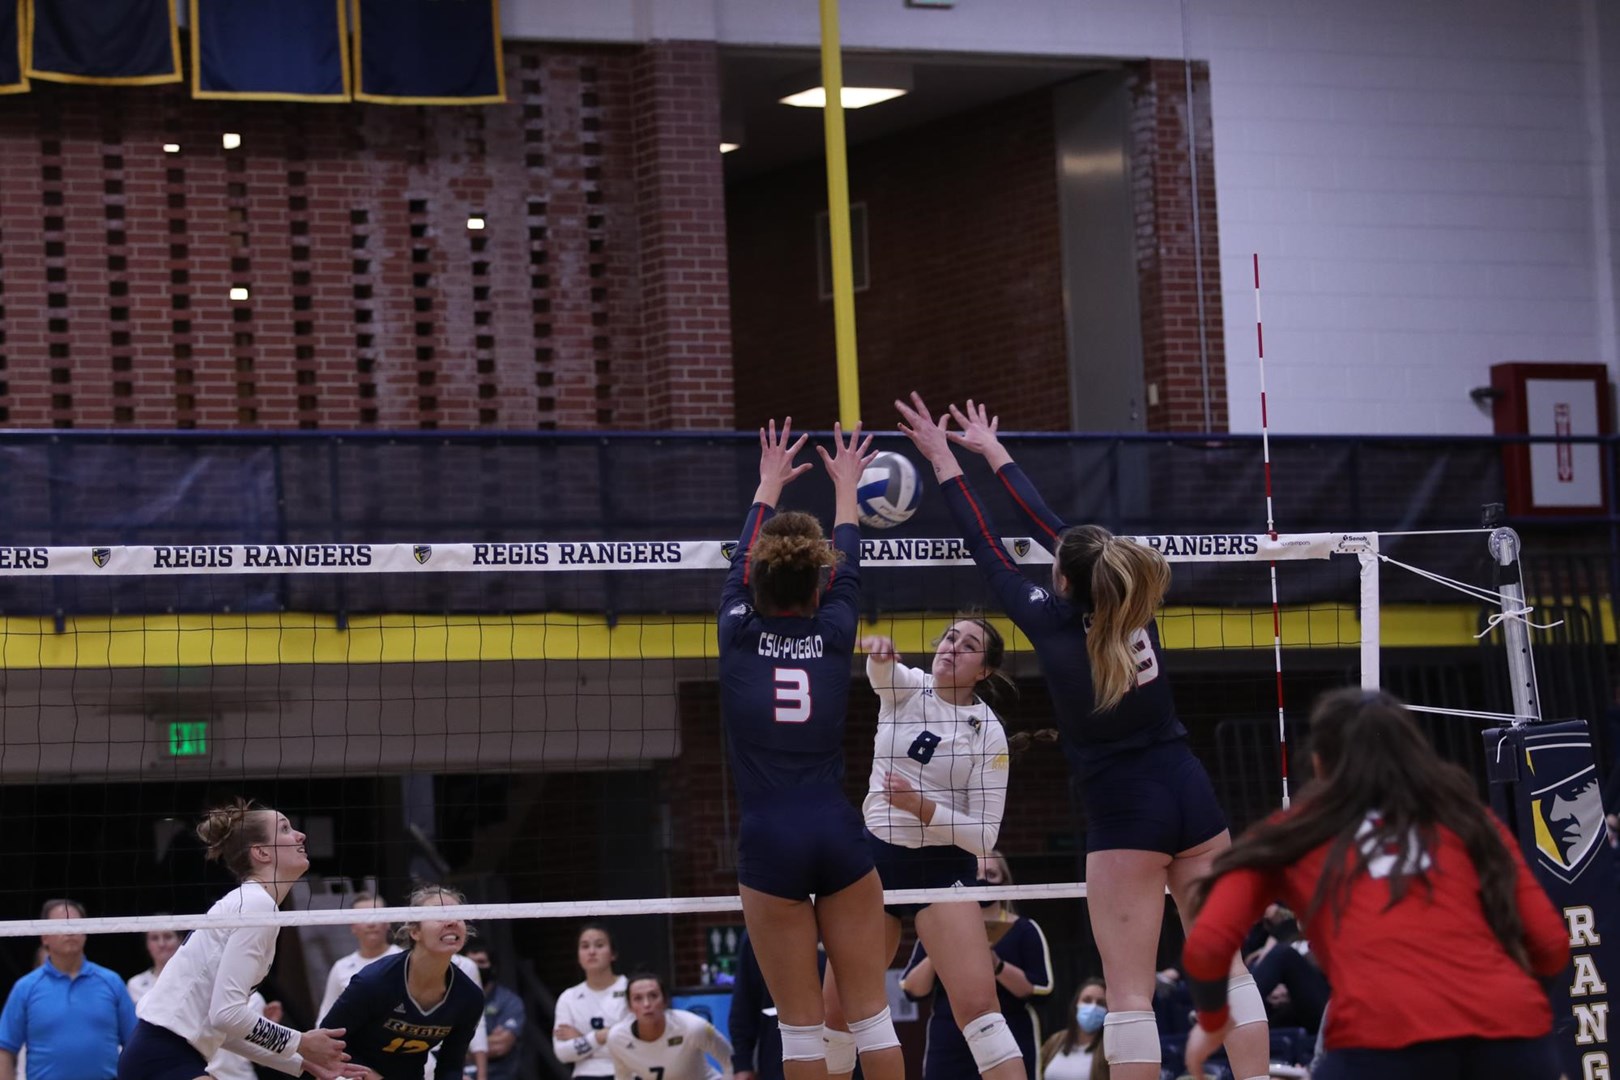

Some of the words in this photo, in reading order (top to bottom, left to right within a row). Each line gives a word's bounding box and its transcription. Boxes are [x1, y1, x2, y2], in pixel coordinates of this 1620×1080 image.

[153, 546, 233, 568] REGIS
[243, 545, 372, 567] RANGERS
[472, 543, 549, 565] REGIS
[558, 542, 682, 564] RANGERS
[1146, 535, 1258, 556] RANGERS
[0, 547, 49, 569] ERS
[758, 631, 823, 660] CSU-PUEBLO
[774, 667, 812, 723] 3
[907, 730, 942, 765] 8
